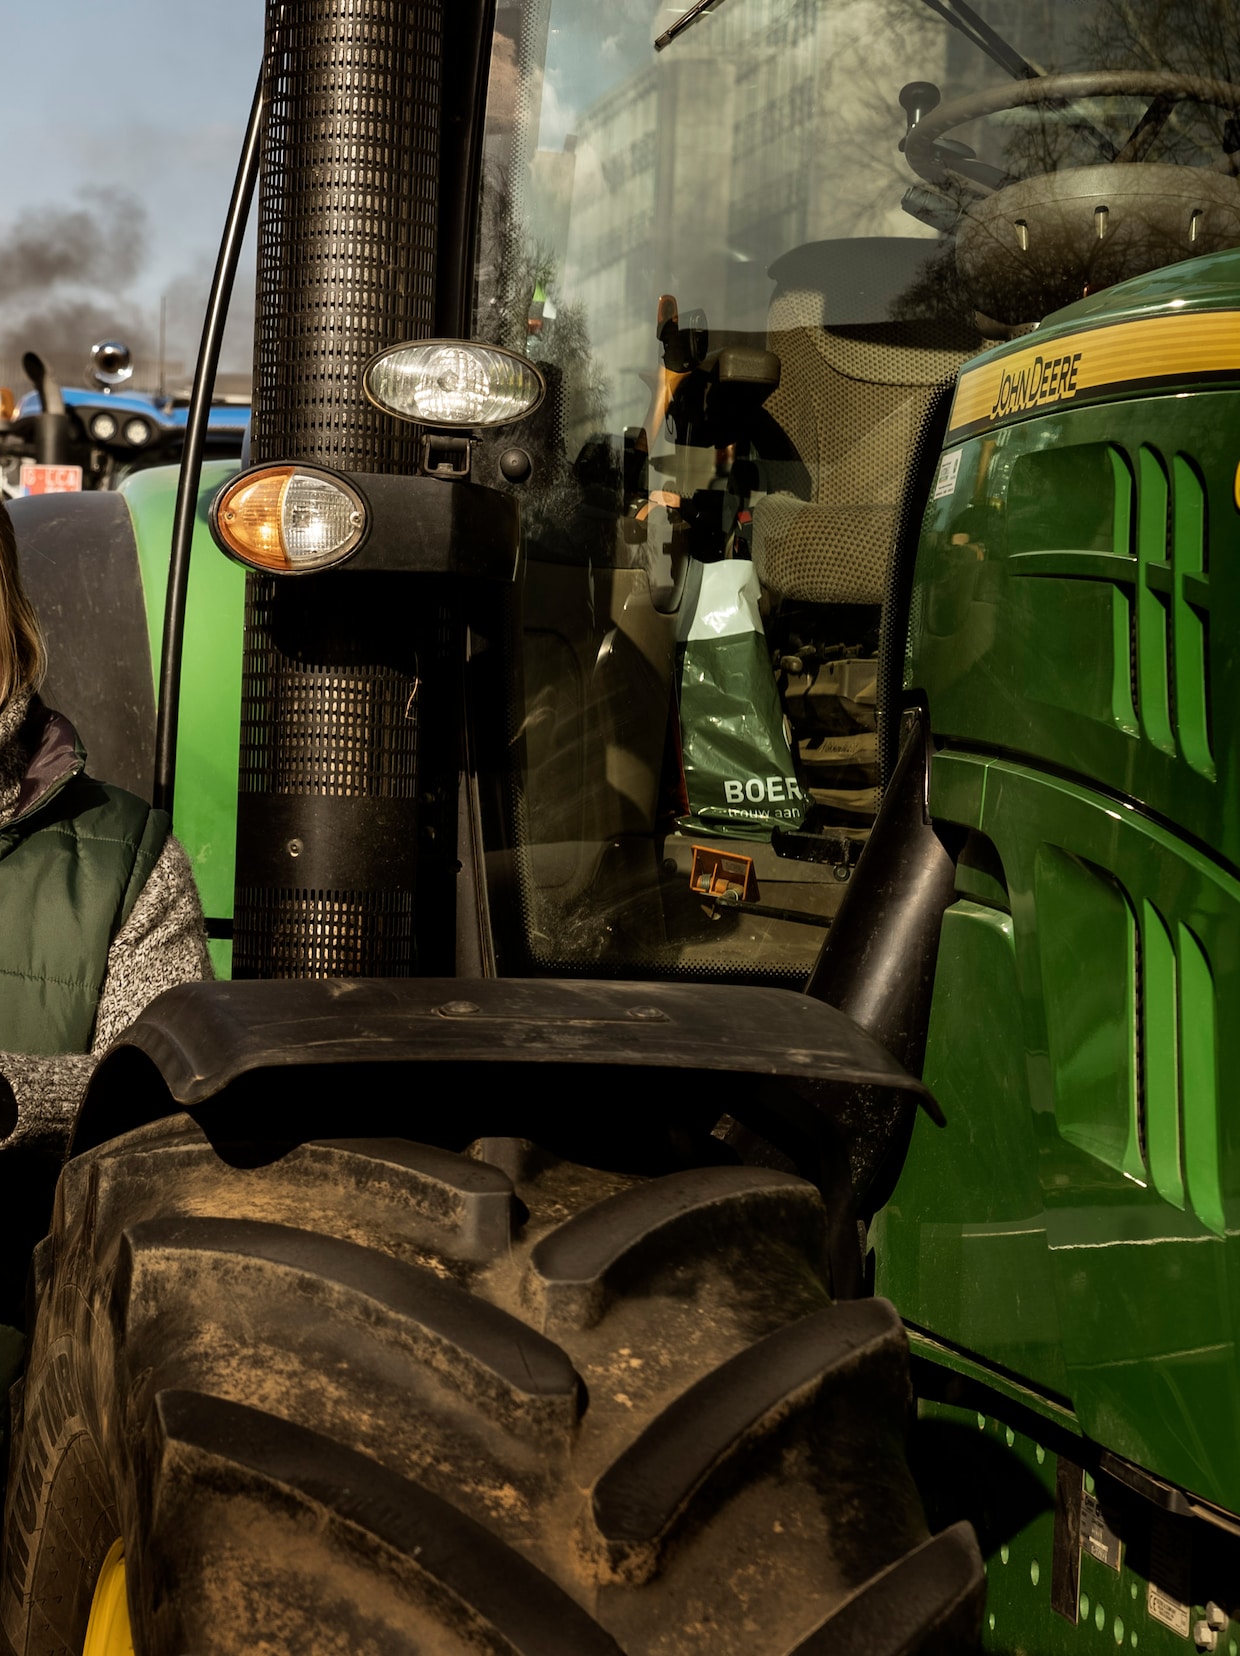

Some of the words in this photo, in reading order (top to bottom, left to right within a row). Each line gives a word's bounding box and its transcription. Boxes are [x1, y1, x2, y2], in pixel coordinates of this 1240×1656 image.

[991, 367, 1032, 416] JOHN
[1027, 352, 1082, 403] DEERE
[774, 807, 801, 819] aan
